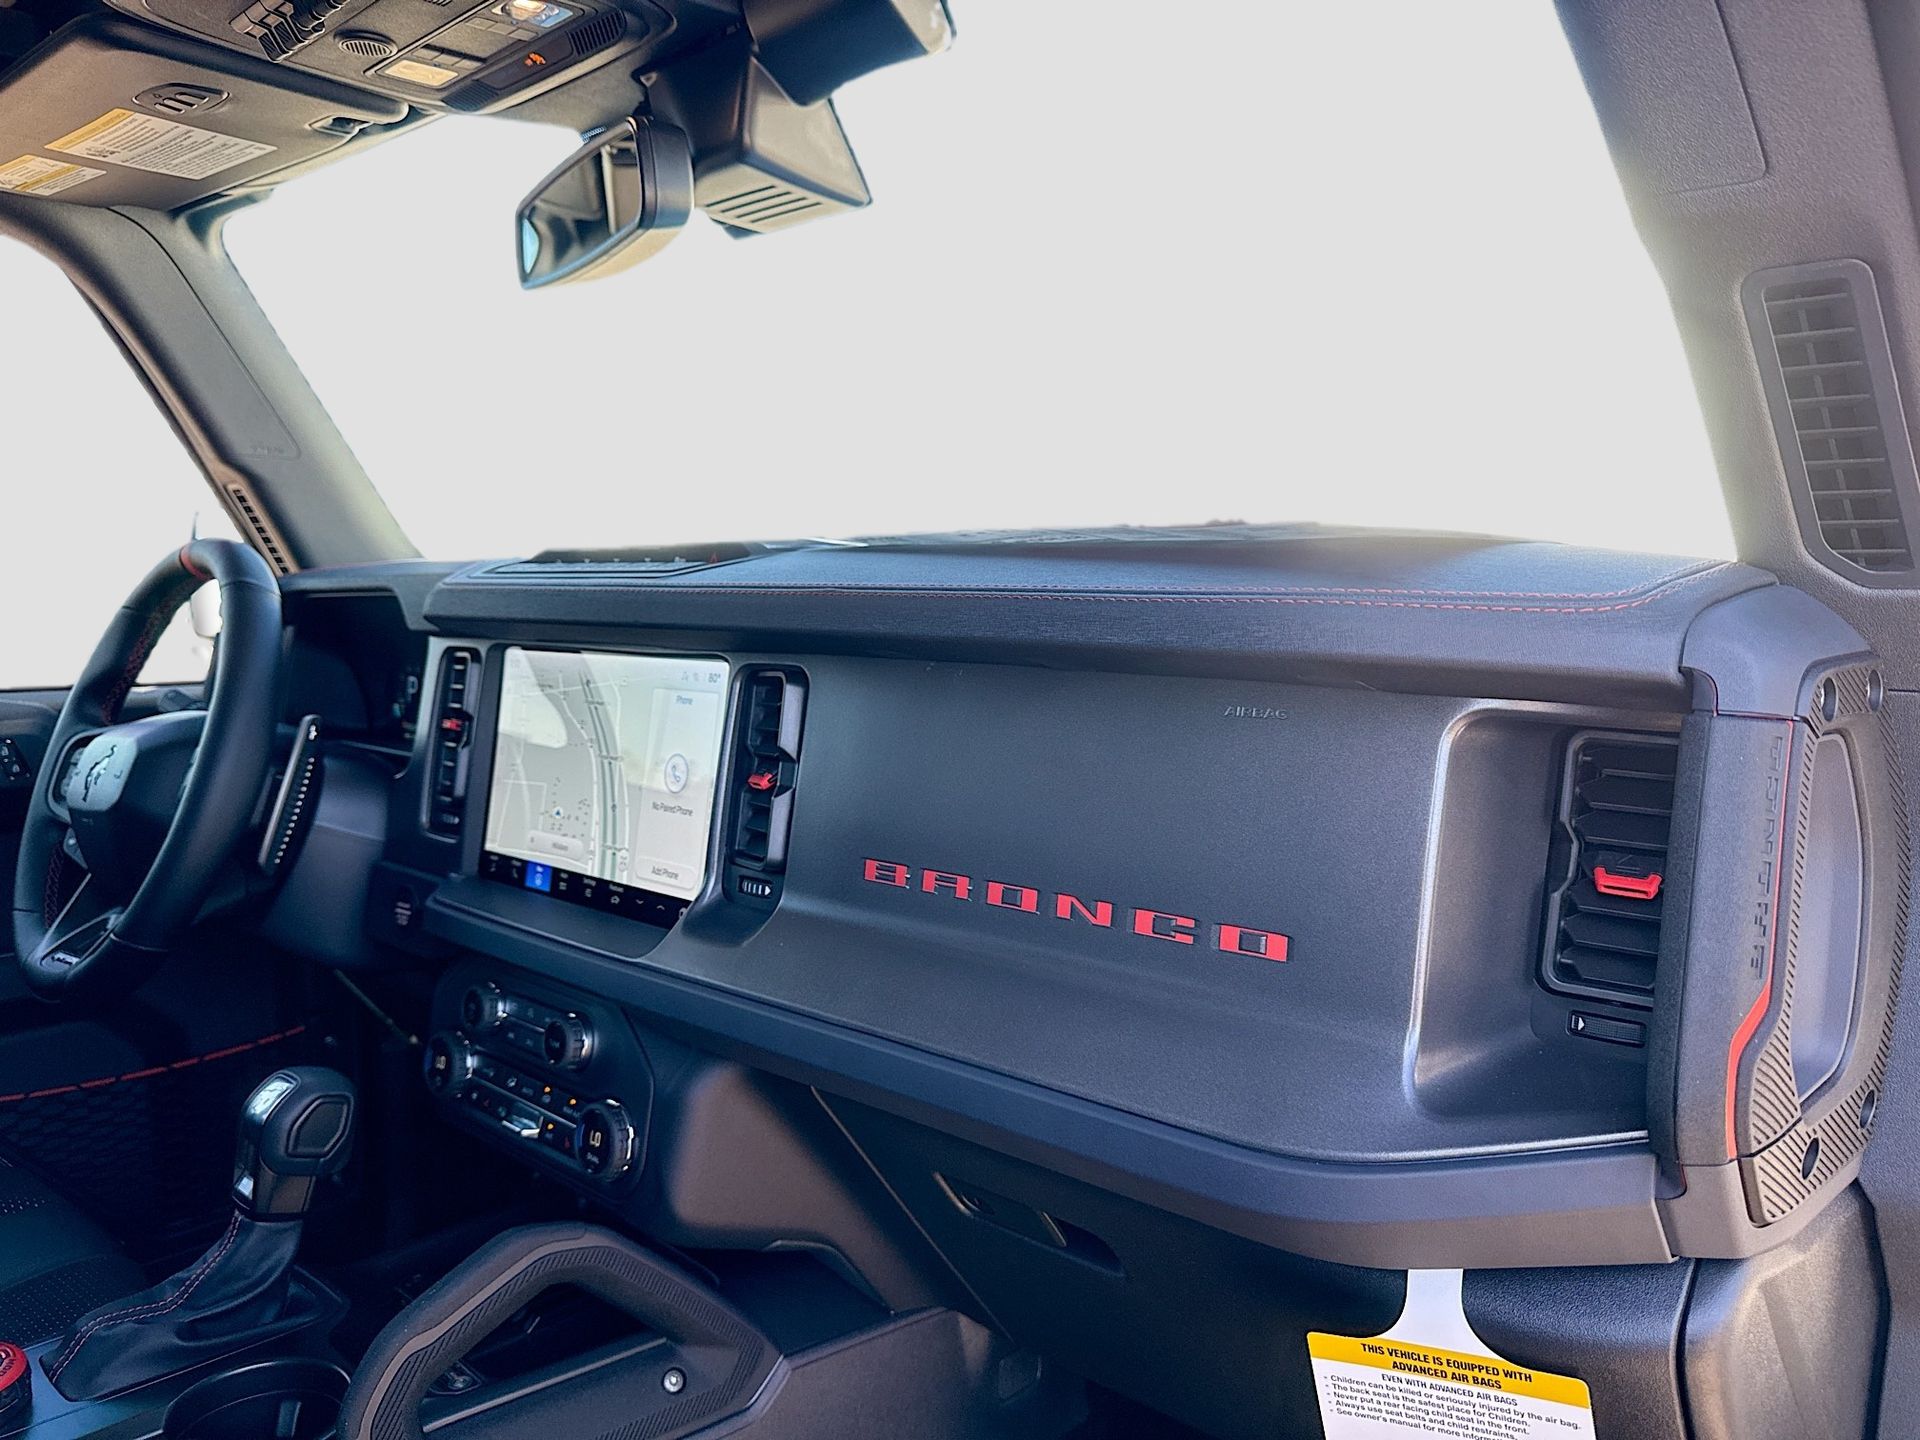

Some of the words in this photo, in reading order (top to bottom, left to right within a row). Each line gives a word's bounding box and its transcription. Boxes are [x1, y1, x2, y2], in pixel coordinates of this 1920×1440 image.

[1224, 705, 1289, 720] AIRBAG
[862, 857, 1290, 963] BRONCO
[1360, 1343, 1385, 1355] THIS
[1387, 1347, 1430, 1364] VEHICLE
[1432, 1355, 1444, 1366] IS
[1446, 1359, 1500, 1376] EQUIPPED
[1502, 1368, 1533, 1382] WITH
[1392, 1361, 1447, 1379] ADVANCED
[1450, 1372, 1469, 1384] AIR
[1472, 1377, 1502, 1389] BAGS
[1330, 1374, 1366, 1387] Children
[1368, 1381, 1384, 1390] can
[1385, 1384, 1397, 1393] be
[1398, 1386, 1422, 1397] killed
[1423, 1391, 1433, 1399] or
[1435, 1395, 1476, 1409] seriously
[1479, 1402, 1511, 1415] injured
[1513, 1409, 1525, 1419] by
[1527, 1411, 1543, 1421] the
[1545, 1415, 1558, 1424] air
[1559, 1418, 1582, 1430] bag.
[1331, 1382, 1348, 1391] The
[1349, 1385, 1371, 1395] back
[1372, 1390, 1390, 1399] seat
[1392, 1393, 1401, 1401] is
[1401, 1395, 1416, 1404] the
[1418, 1398, 1445, 1410] safest
[1447, 1404, 1471, 1415] place
[1473, 1409, 1486, 1418] for
[1488, 1412, 1531, 1427] Children.
[1381, 1374, 1402, 1384] EVEN
[1404, 1378, 1427, 1388] WITH
[1429, 1382, 1474, 1398] ADVANCED
[1476, 1391, 1492, 1401] AIR
[1494, 1395, 1518, 1406] BAGS
[1333, 1391, 1358, 1402] Never
[1360, 1396, 1374, 1406] put
[1383, 1401, 1400, 1409] rear
[1402, 1403, 1430, 1416] facing
[1431, 1410, 1453, 1420] child
[1455, 1414, 1474, 1424] seat
[1476, 1418, 1485, 1426] in
[1487, 1420, 1503, 1430] the
[1504, 1423, 1530, 1435] front.
[1335, 1400, 1365, 1412] Always
[1367, 1406, 1383, 1414] use
[1385, 1409, 1403, 1418] seat
[1405, 1412, 1426, 1422] belts
[1428, 1417, 1445, 1427] and
[1447, 1420, 1469, 1431] child
[1471, 1426, 1519, 1440] restraints.
[1336, 1407, 1353, 1416] See
[1354, 1411, 1387, 1423] owner's
[1389, 1418, 1421, 1429] manual
[1422, 1423, 1435, 1432] for
[1437, 1427, 1460, 1437] more
